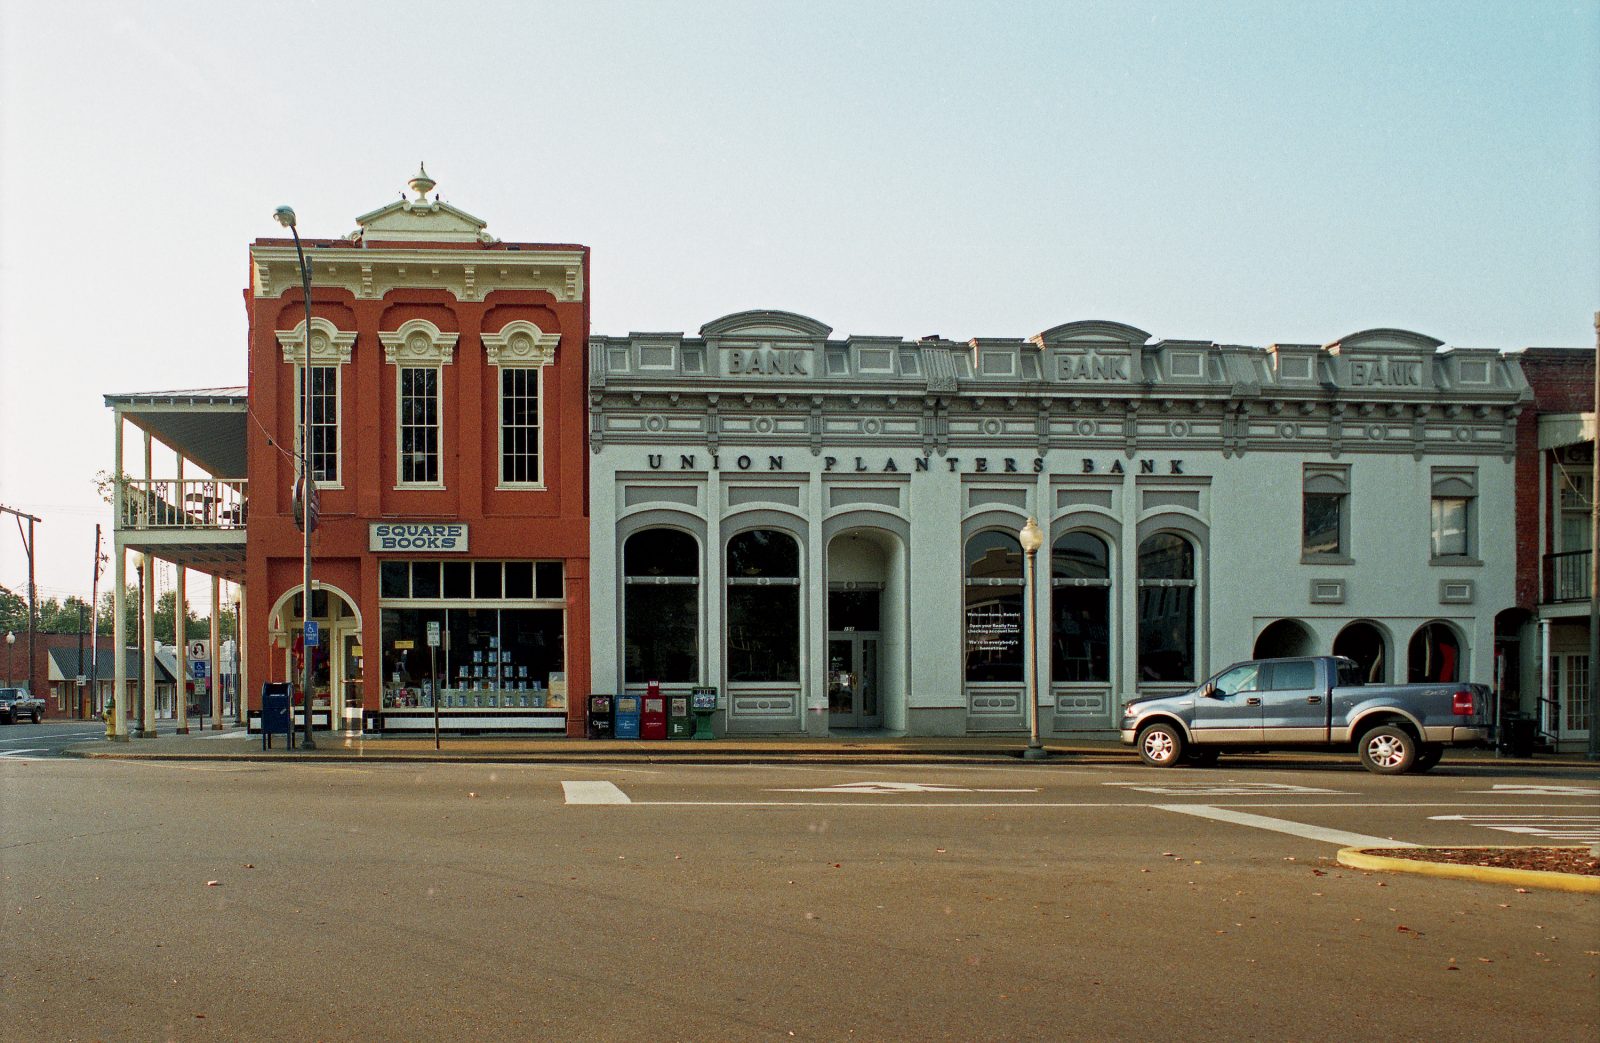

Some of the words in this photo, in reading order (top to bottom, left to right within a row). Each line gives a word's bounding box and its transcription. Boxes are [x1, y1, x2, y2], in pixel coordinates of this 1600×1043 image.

[729, 350, 808, 375] BANK
[1058, 356, 1127, 380] BANK
[1351, 362, 1418, 386] BANK
[648, 454, 783, 470] UNION
[824, 456, 1044, 473] PLANTERS
[1082, 458, 1183, 474] BANK
[376, 525, 462, 537] SQUARE
[382, 537, 456, 549] BOOKS
